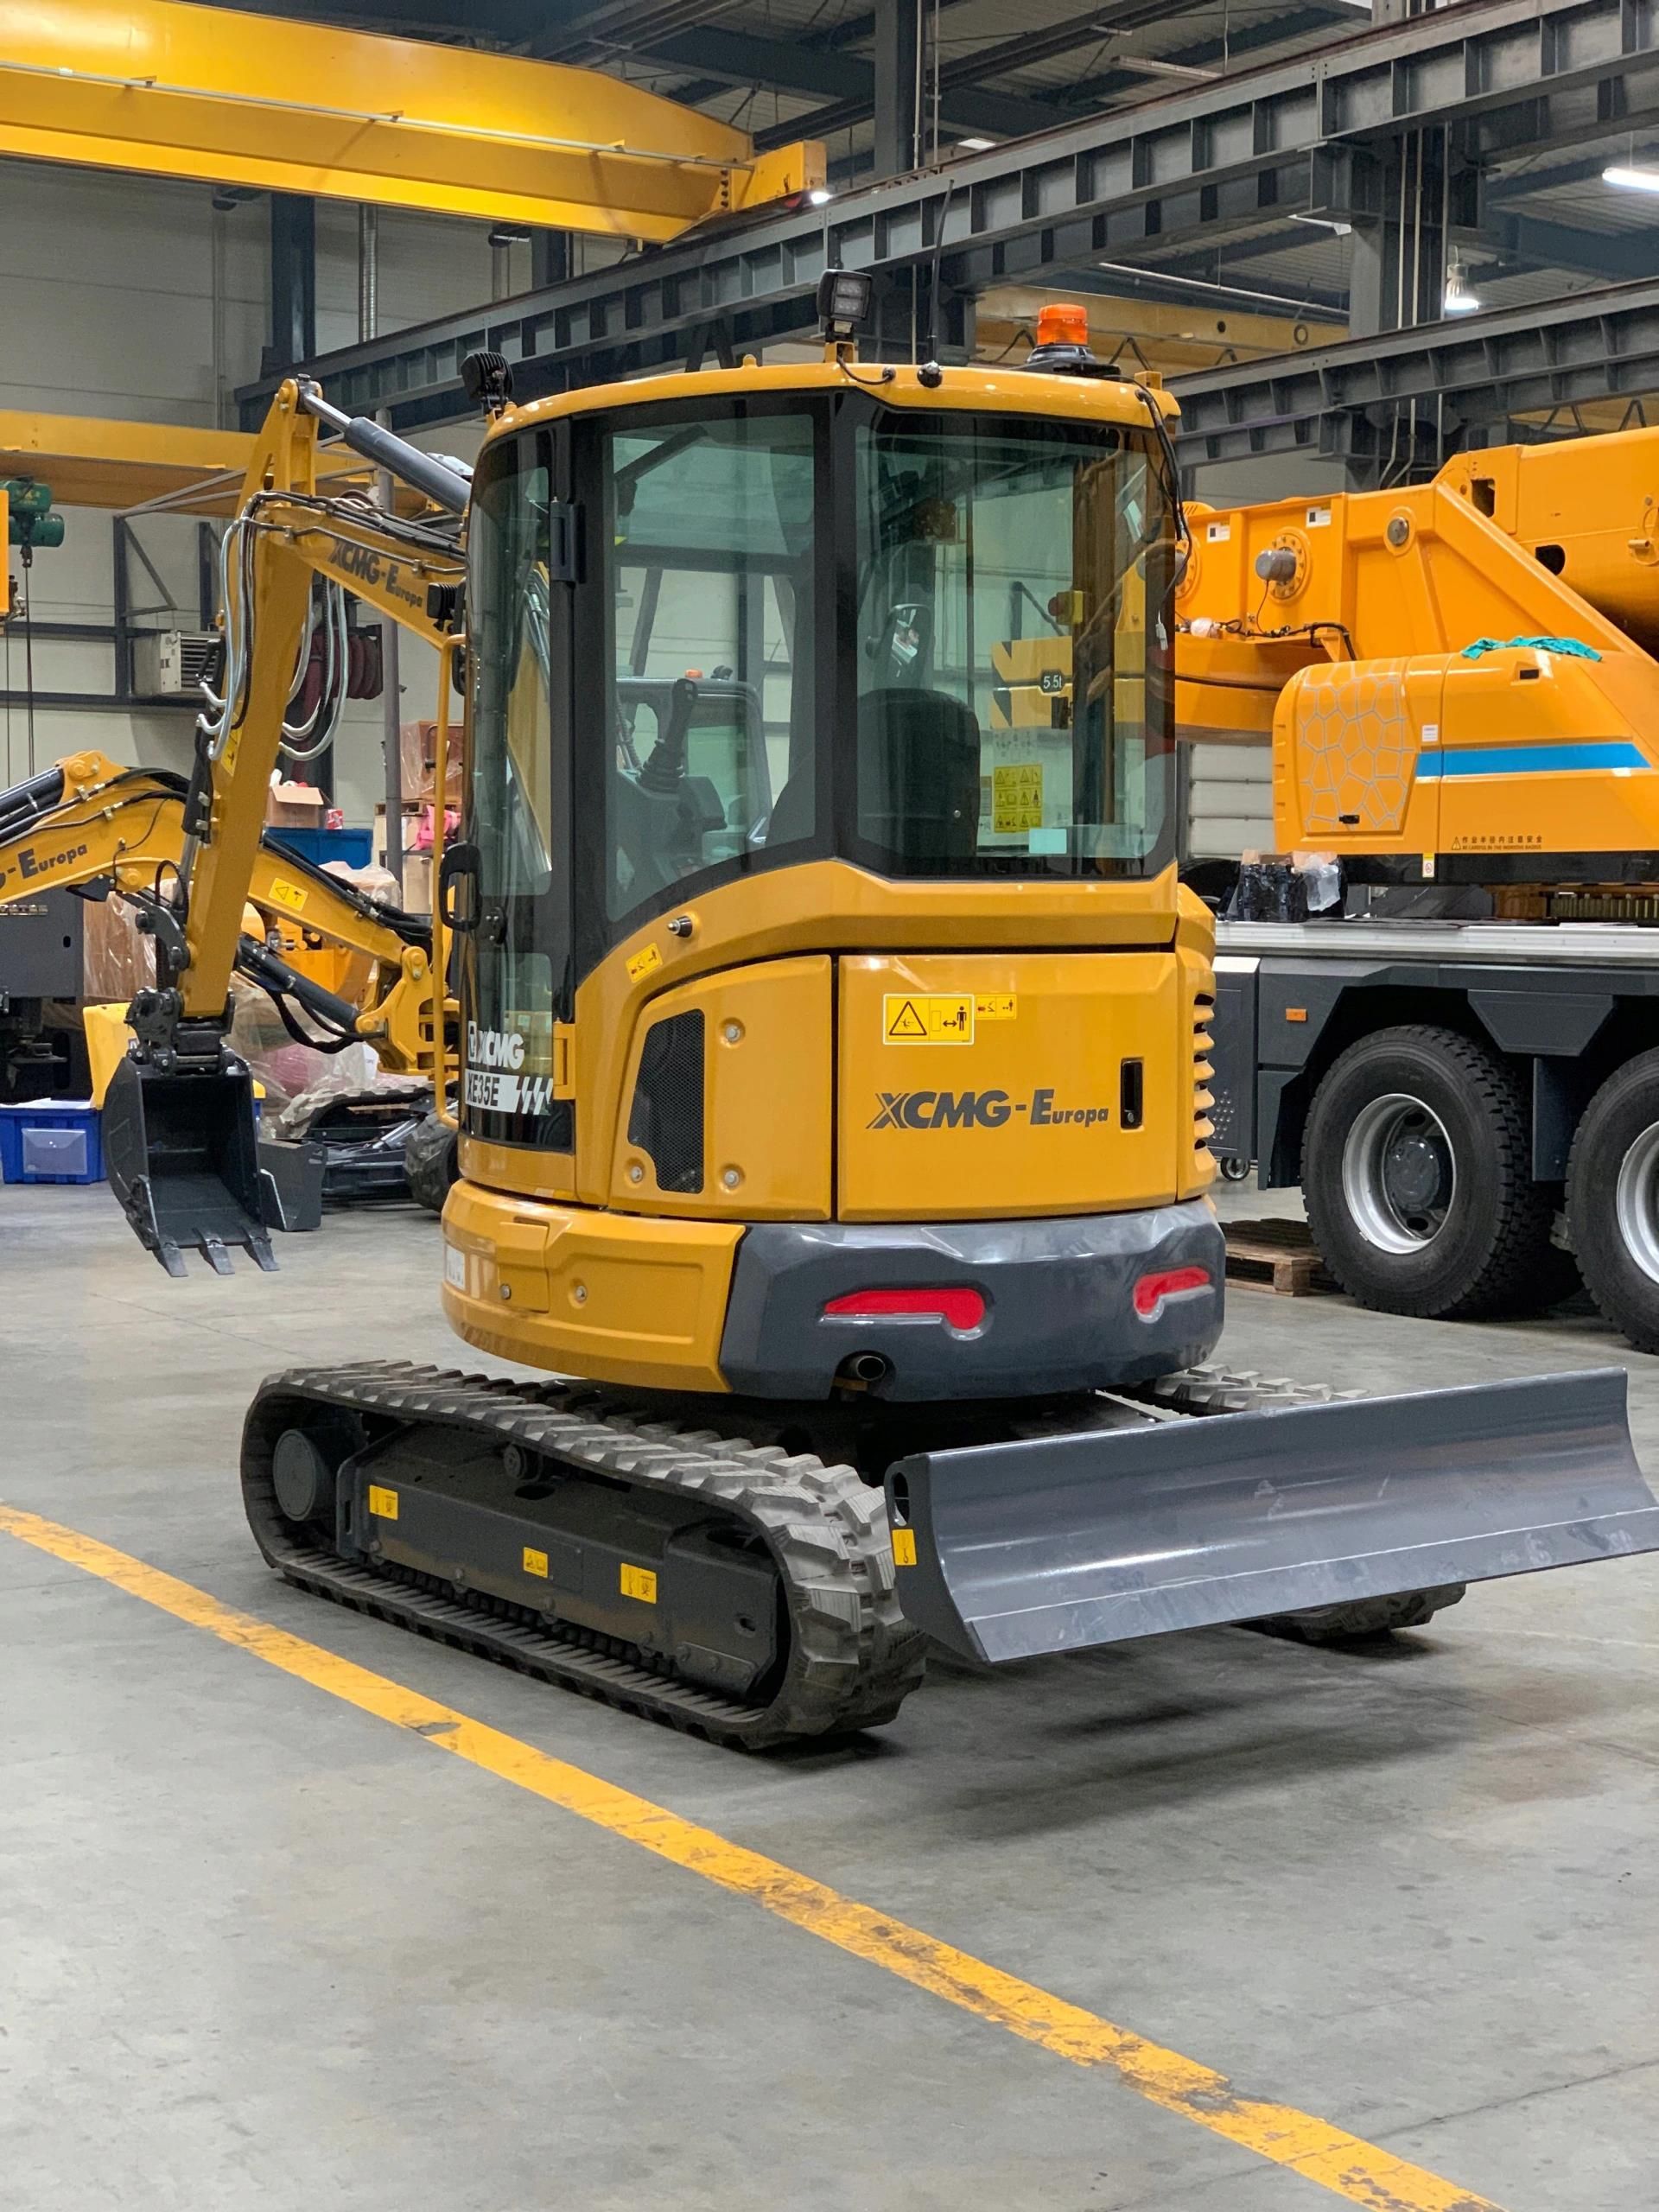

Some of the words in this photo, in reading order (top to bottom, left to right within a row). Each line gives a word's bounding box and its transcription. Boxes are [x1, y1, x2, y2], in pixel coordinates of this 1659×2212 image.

[477, 1030, 524, 1070] XCMG
[467, 1072, 500, 1107] XE35E
[865, 1088, 1109, 1129] XCMG-Europa
